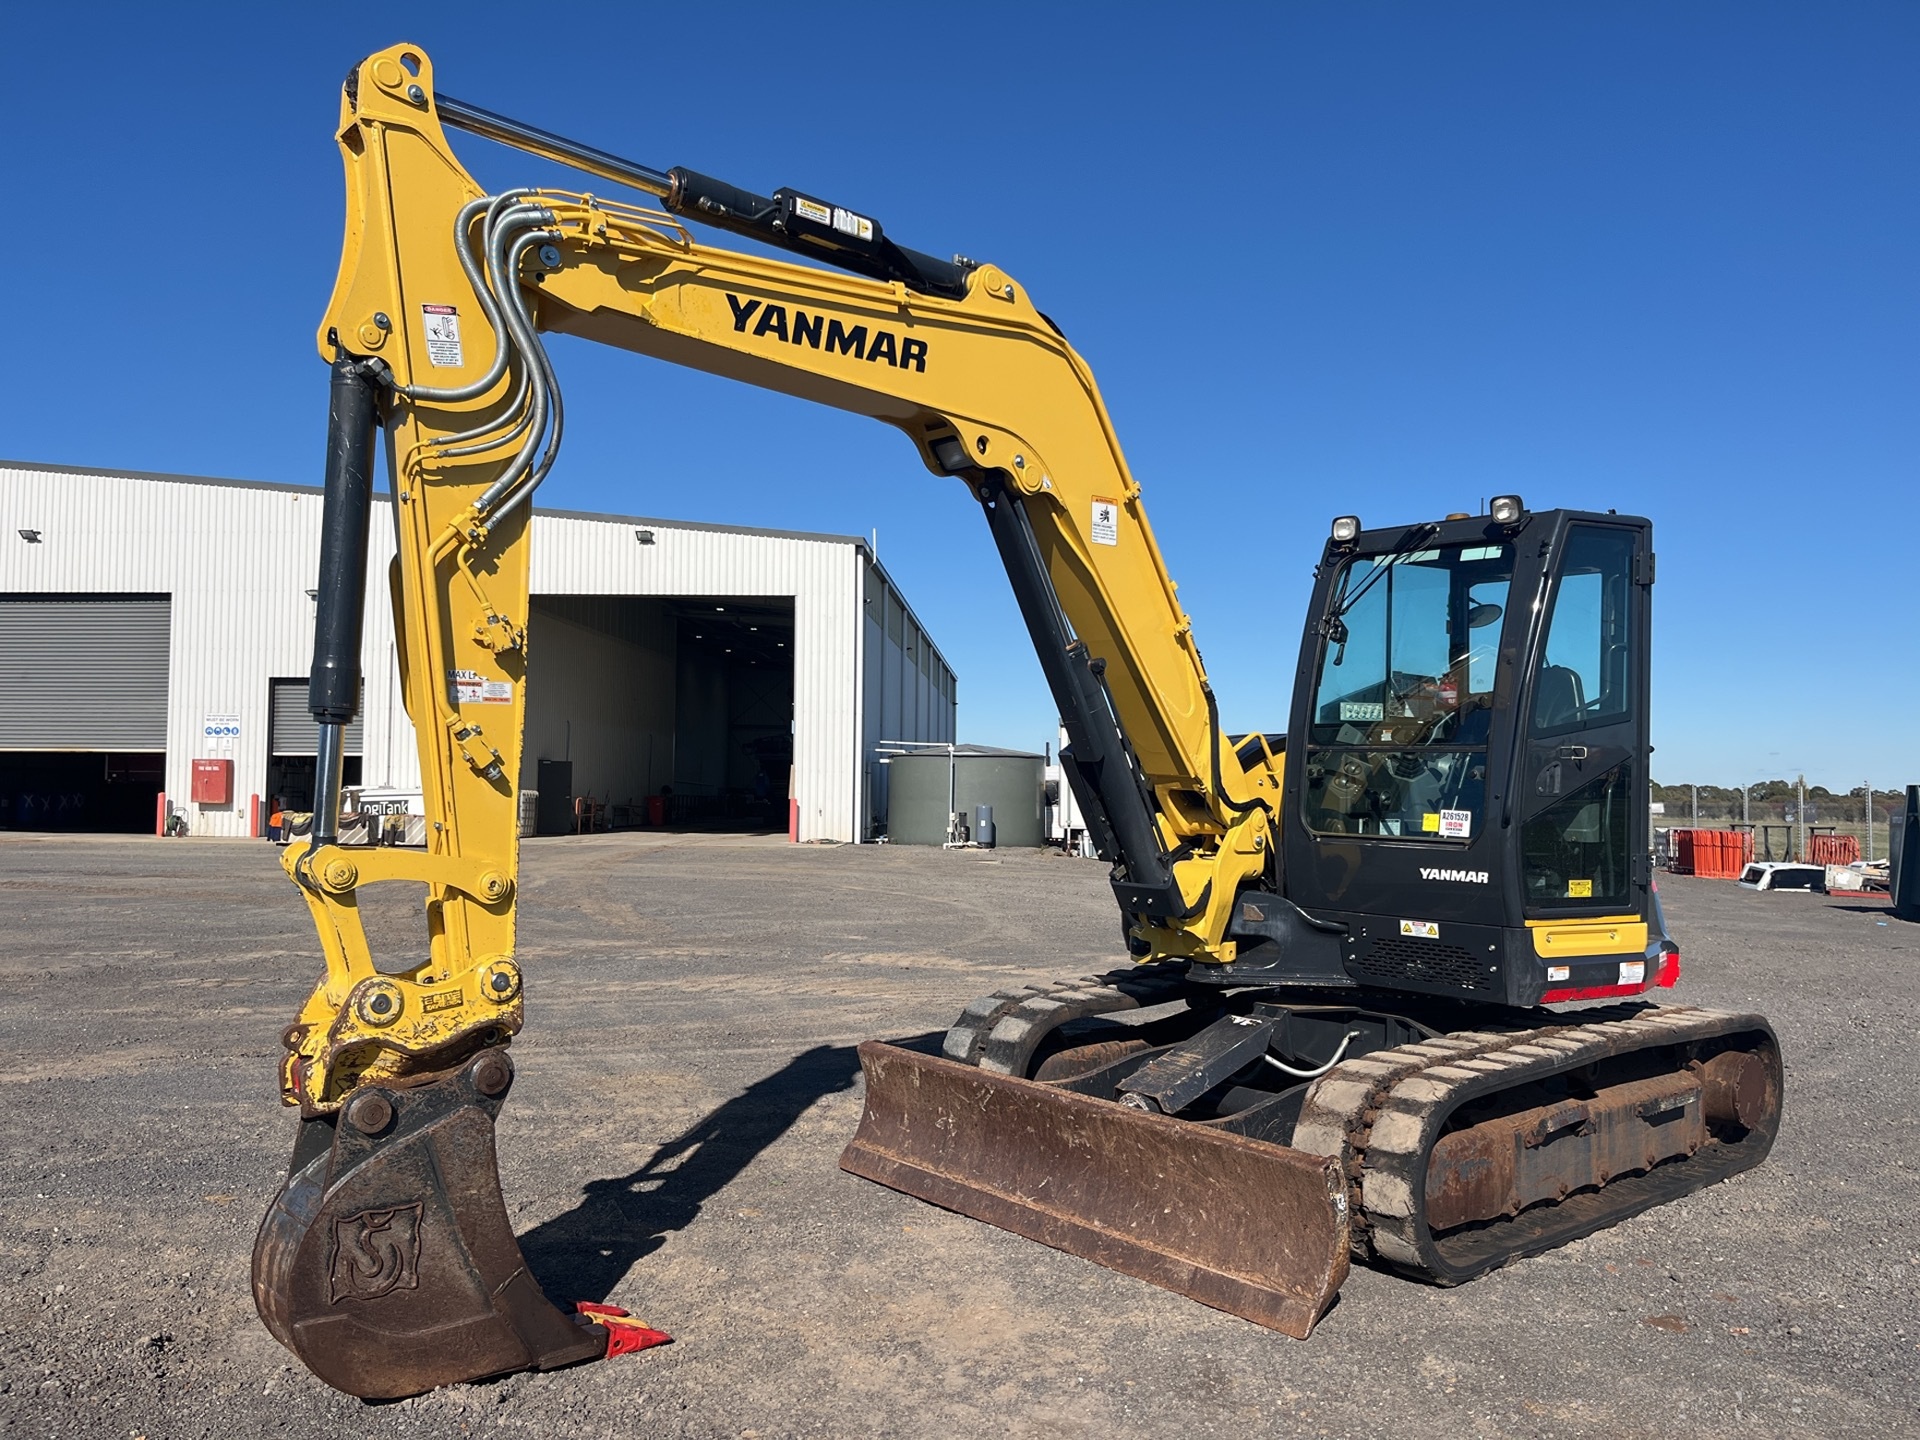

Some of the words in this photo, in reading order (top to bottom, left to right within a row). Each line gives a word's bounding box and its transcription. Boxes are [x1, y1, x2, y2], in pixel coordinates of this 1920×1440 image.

[725, 293, 928, 373] YANMAR
[447, 670, 467, 680] MAX
[1442, 811, 1469, 822] A261528
[1445, 821, 1464, 829] IRON
[1419, 867, 1489, 884] YANMAR
